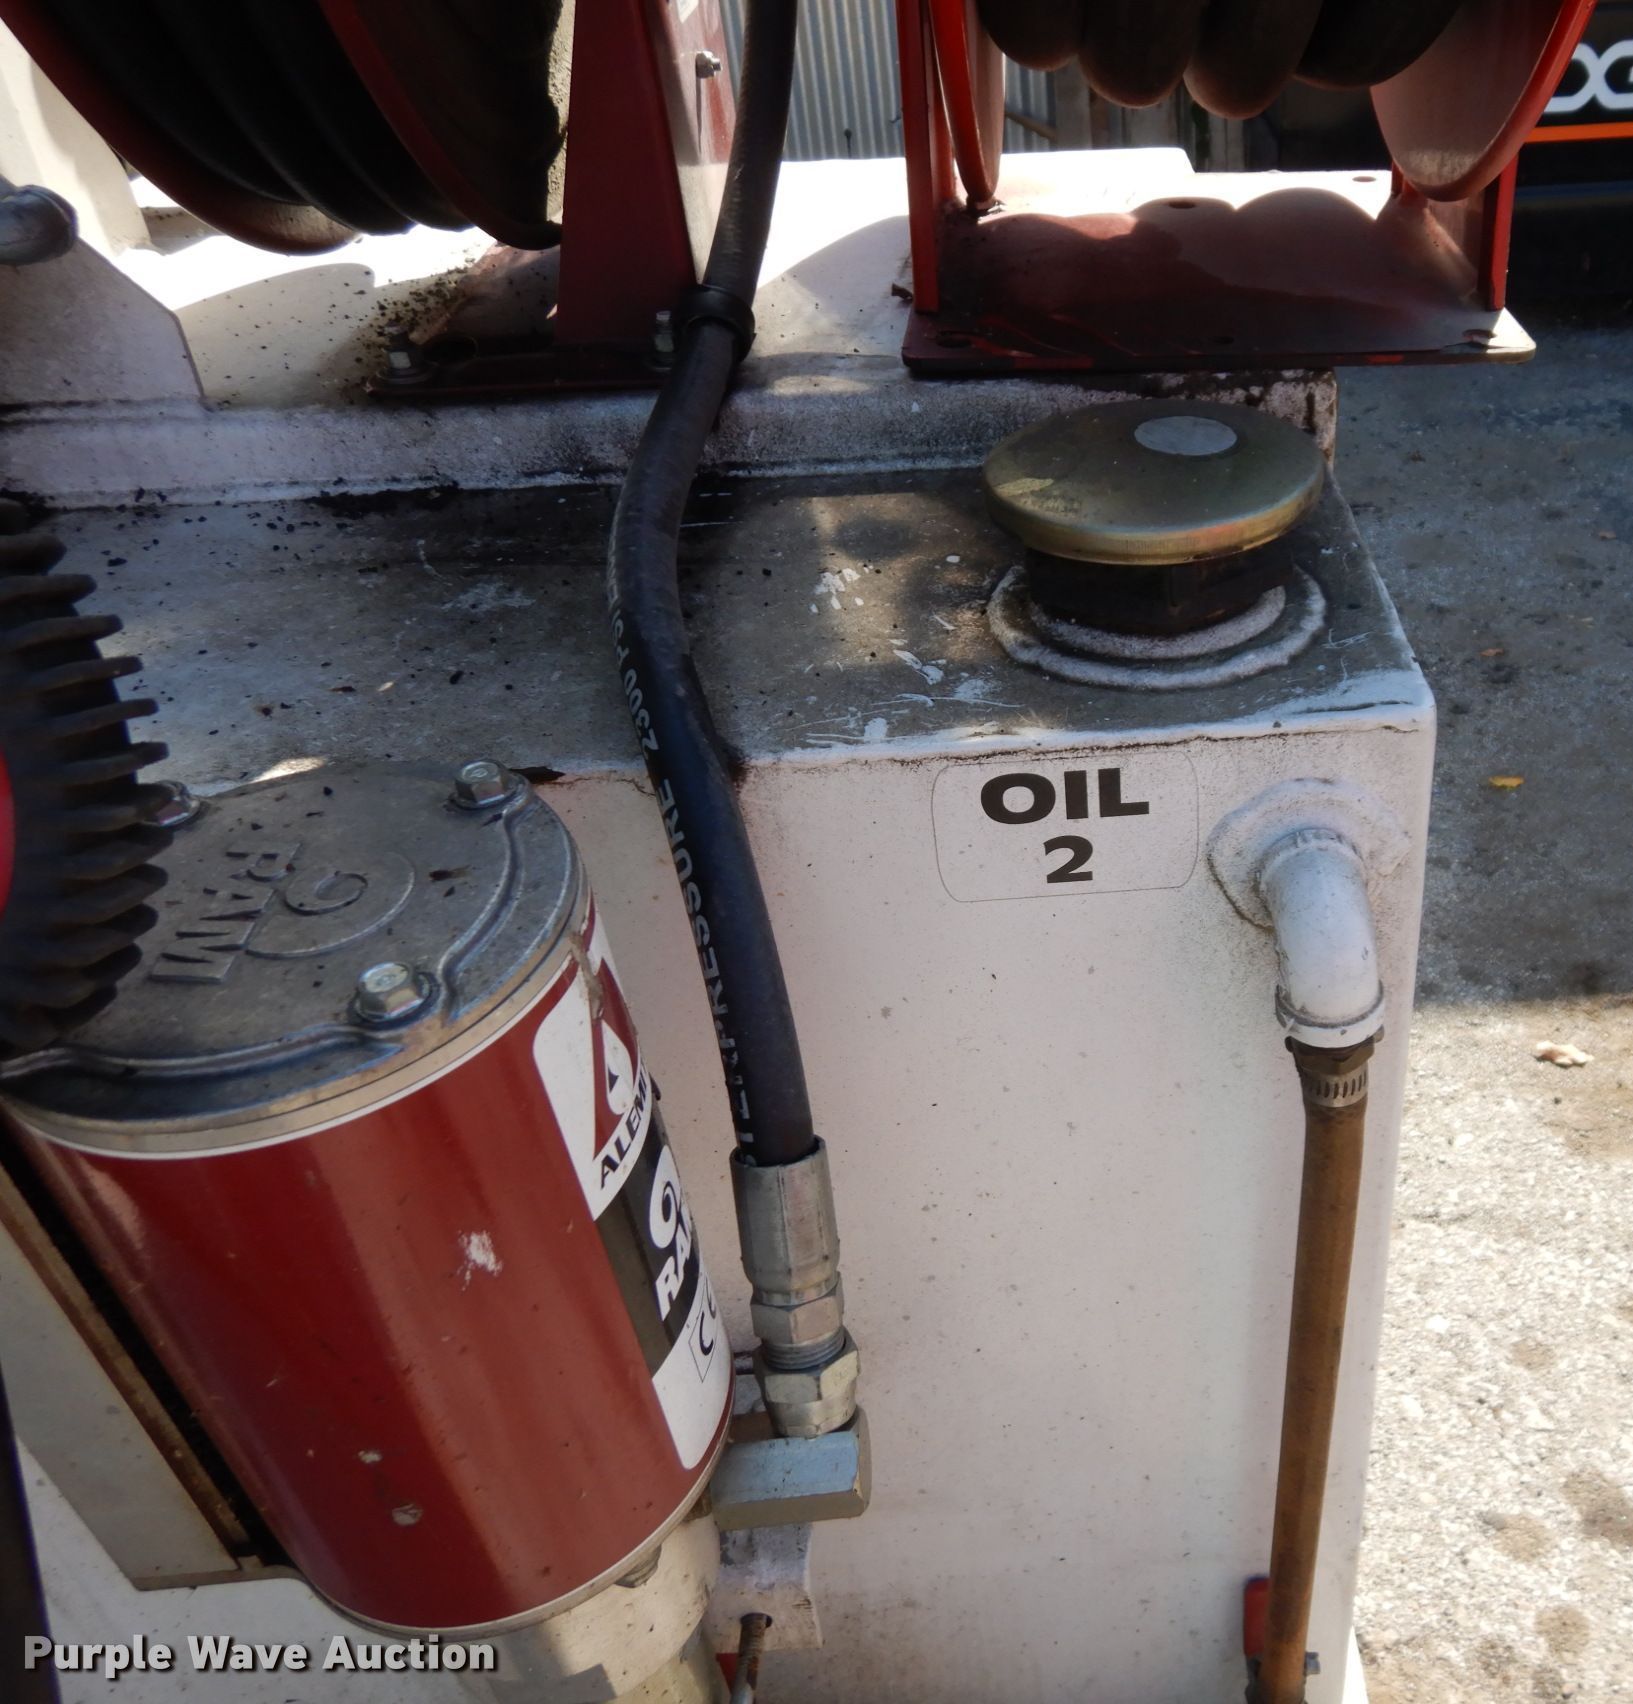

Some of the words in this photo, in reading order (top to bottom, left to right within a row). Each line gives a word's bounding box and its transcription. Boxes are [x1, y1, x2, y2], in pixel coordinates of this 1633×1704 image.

[623, 667, 659, 756] 2300
[980, 767, 1150, 825] OIL
[1043, 835, 1094, 883] 2
[660, 778, 737, 1050] PRESSURE
[601, 1062, 647, 1189] ALEMI
